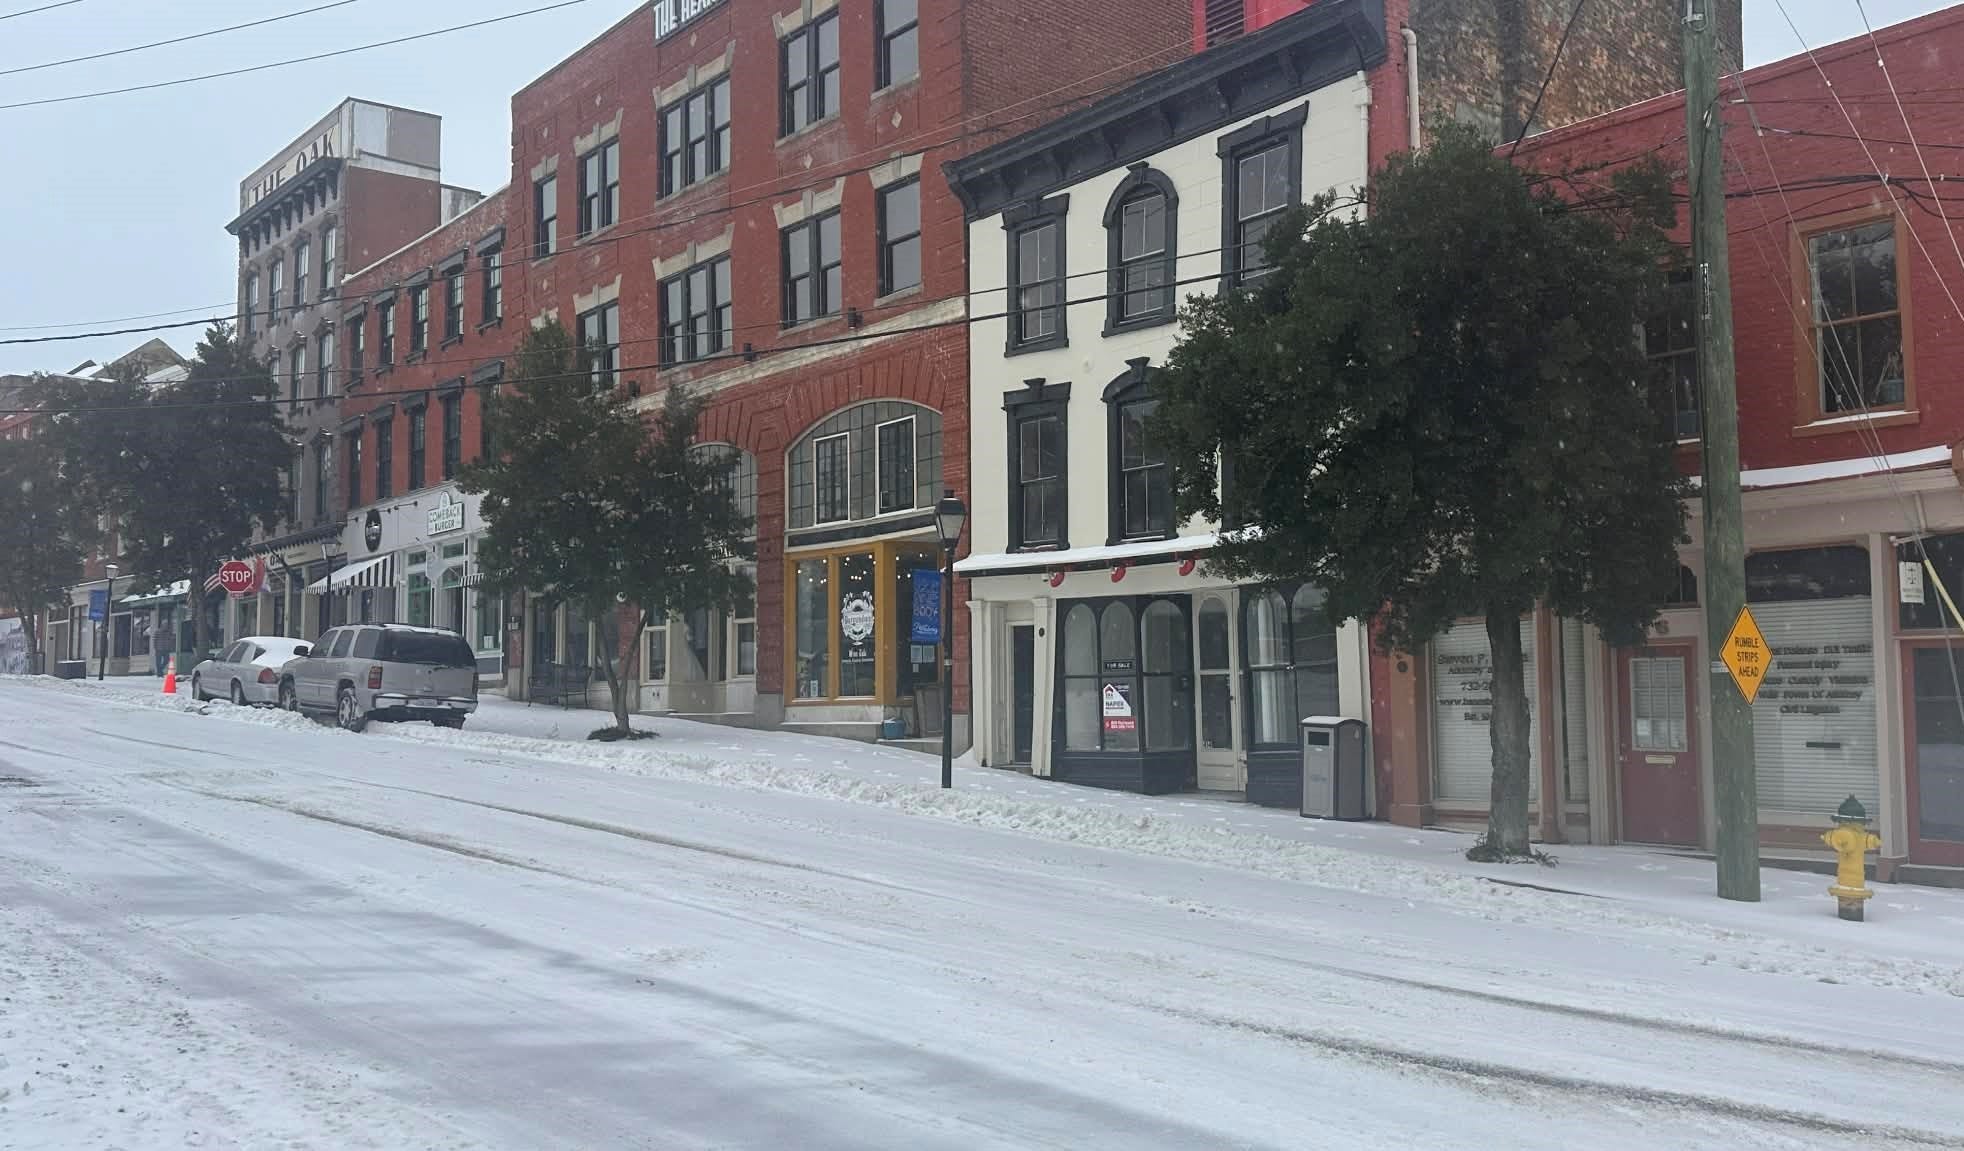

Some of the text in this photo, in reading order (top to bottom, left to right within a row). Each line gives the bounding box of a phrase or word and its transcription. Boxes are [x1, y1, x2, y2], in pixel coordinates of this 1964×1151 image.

[654, 0, 678, 39] THE
[296, 127, 335, 175] OAK
[434, 519, 455, 532] BURGER
[222, 570, 251, 582] STOP
[1734, 636, 1760, 649] RUMBLE
[1736, 651, 1760, 663] STRIPS
[1738, 666, 1759, 677] AHEAD
